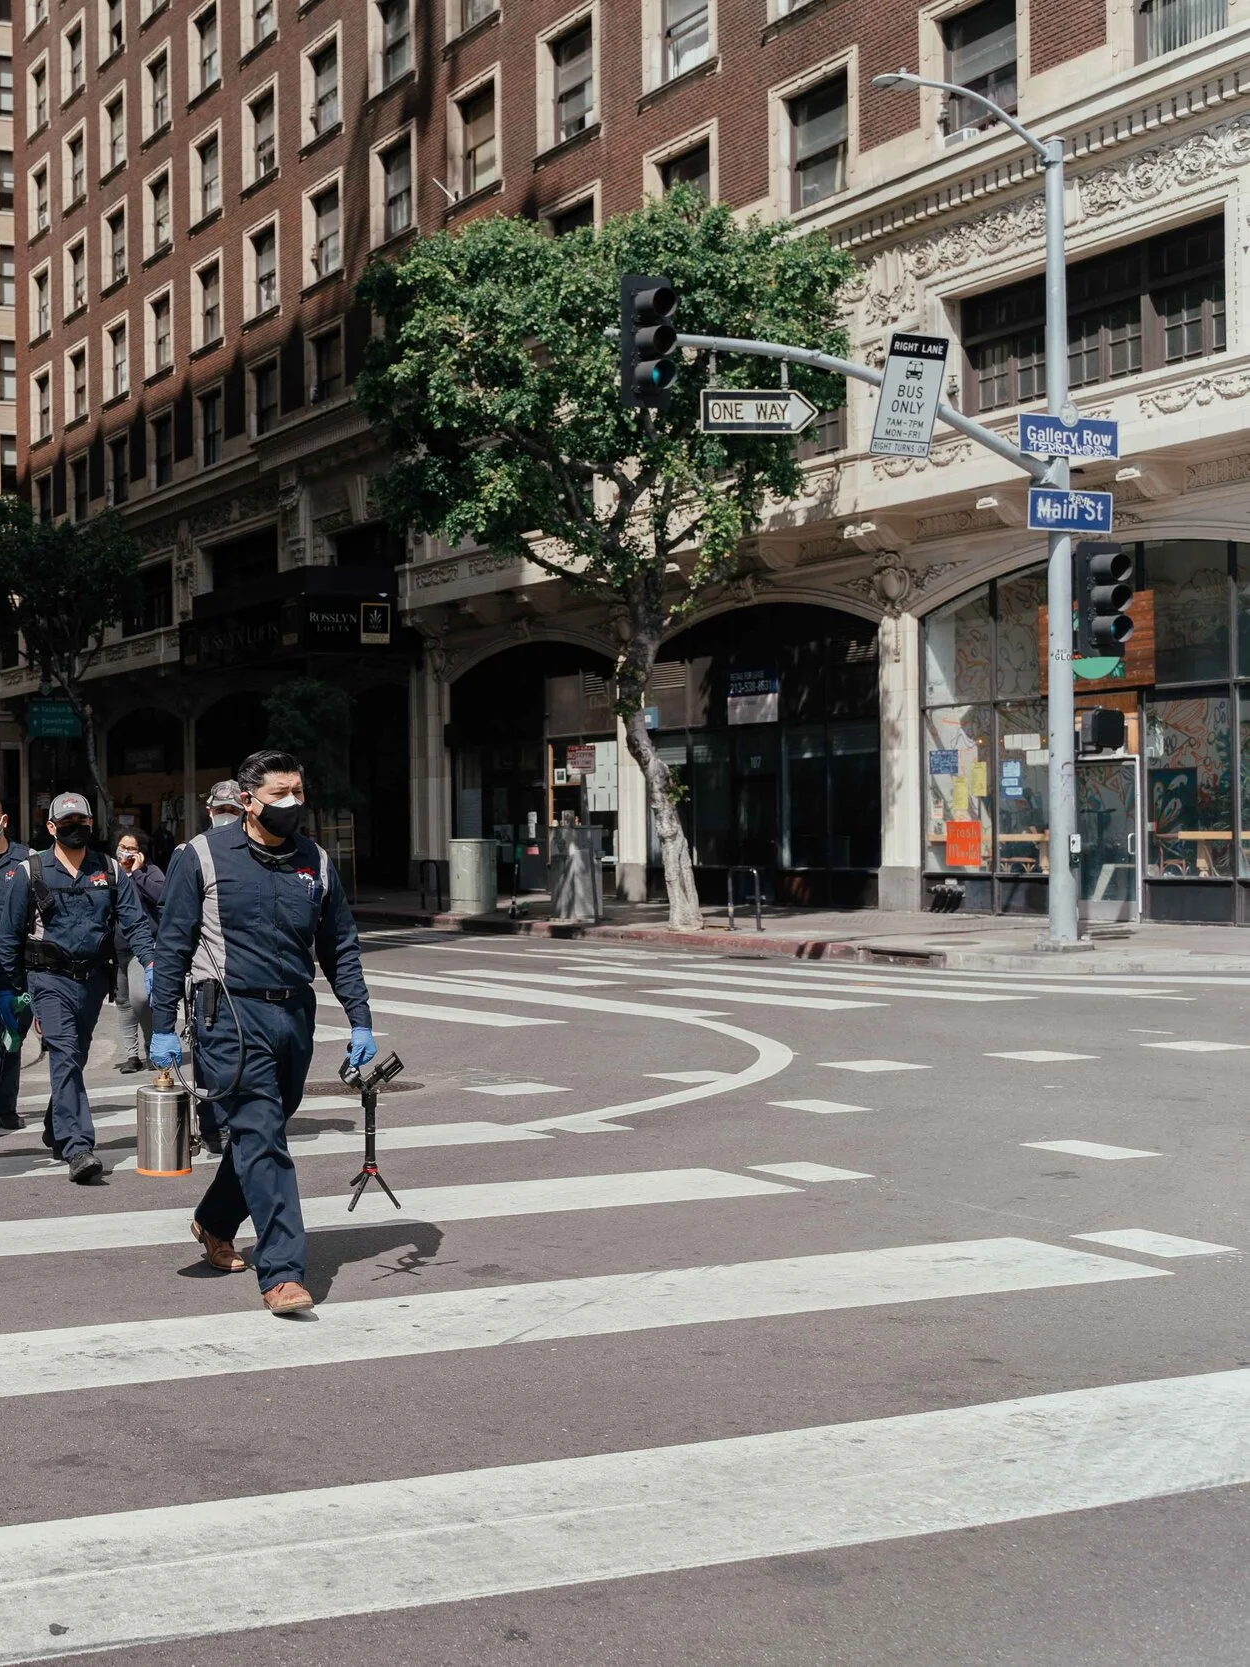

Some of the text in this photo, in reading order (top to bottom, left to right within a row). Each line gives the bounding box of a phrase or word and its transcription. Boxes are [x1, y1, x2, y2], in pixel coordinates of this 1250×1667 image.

[894, 341, 944, 355] RIGHT LANE
[897, 384, 924, 399] BUS
[712, 402, 788, 420] ONE WAY
[891, 400, 925, 414] ONLY
[1026, 425, 1112, 447] Gallery Row
[873, 441, 926, 454] RIGHT TURNS OK
[1037, 497, 1078, 520] Main
[1084, 501, 1104, 521] St
[310, 611, 358, 624] ROSSLYN
[317, 624, 350, 633] LOFTS
